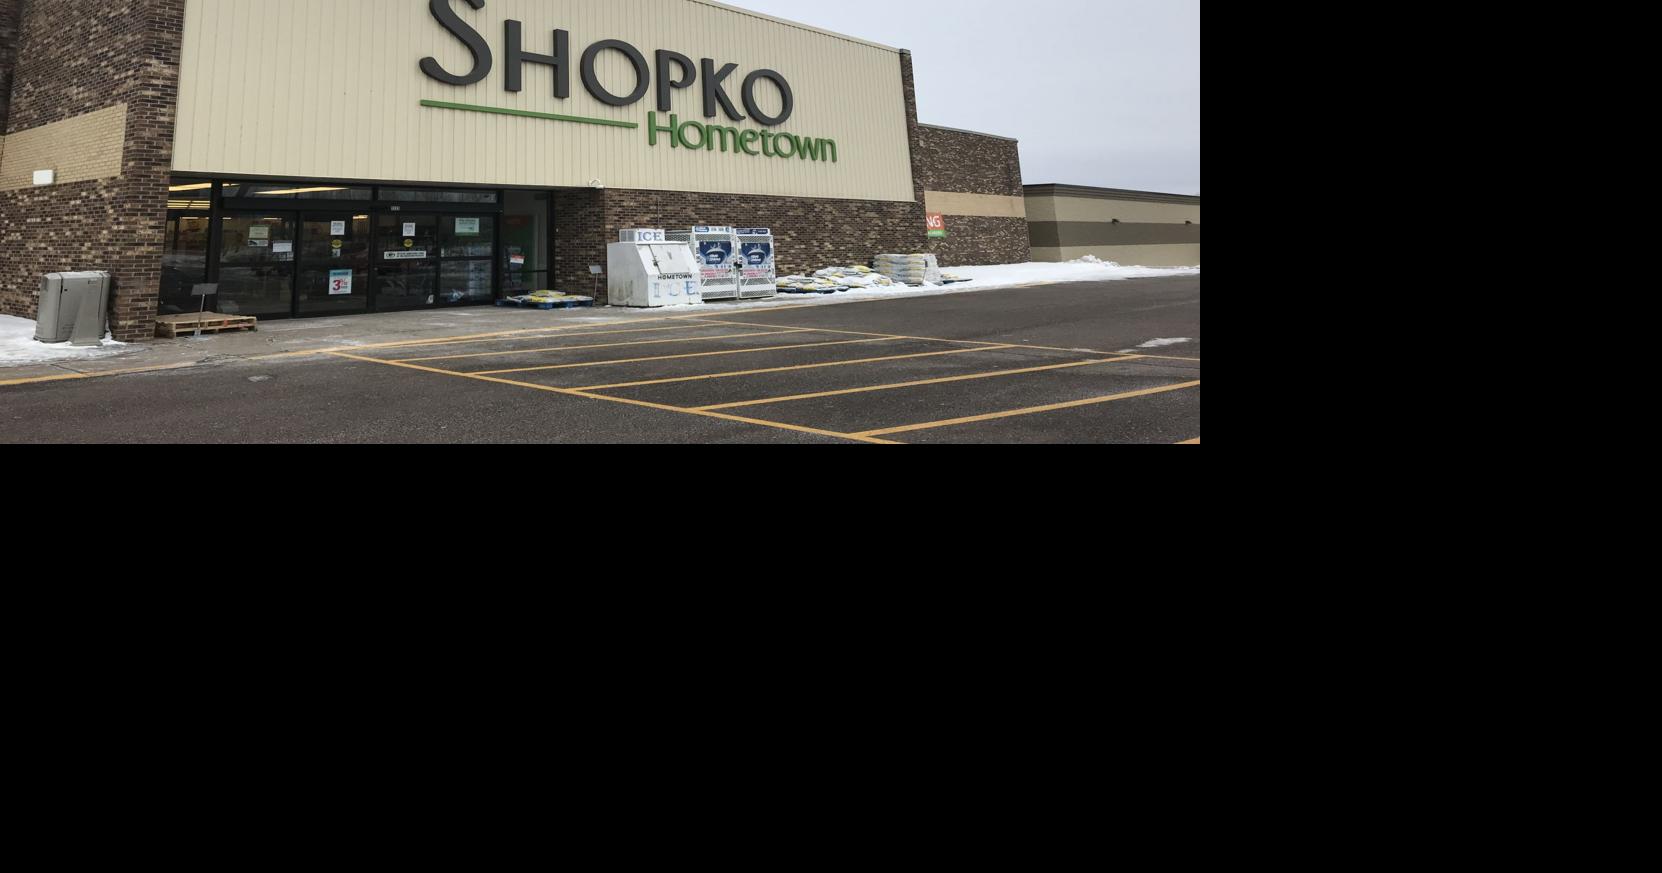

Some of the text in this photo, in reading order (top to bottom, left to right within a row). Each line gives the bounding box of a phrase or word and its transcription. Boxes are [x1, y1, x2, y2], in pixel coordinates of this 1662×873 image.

[419, 0, 794, 126] SHOPKO
[648, 111, 838, 163] Hometown
[637, 231, 662, 241] ICE
[653, 280, 697, 298] ICE
